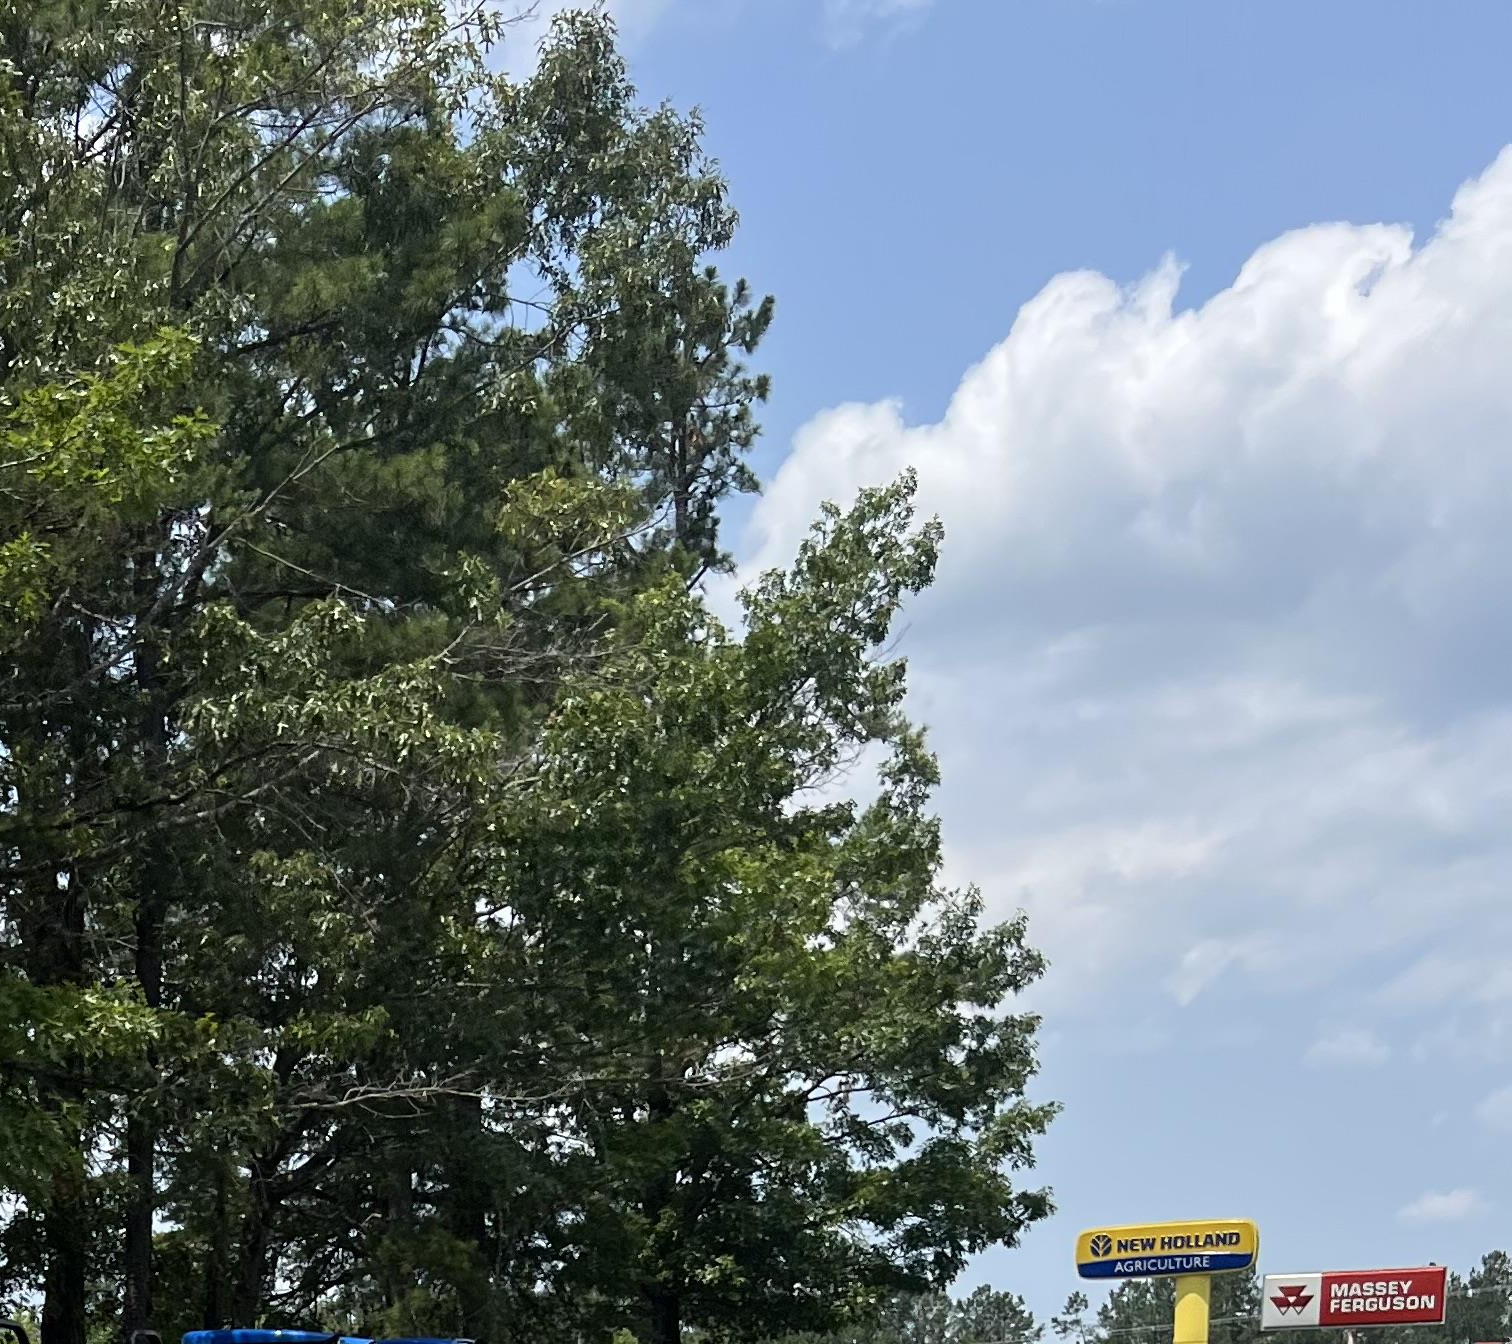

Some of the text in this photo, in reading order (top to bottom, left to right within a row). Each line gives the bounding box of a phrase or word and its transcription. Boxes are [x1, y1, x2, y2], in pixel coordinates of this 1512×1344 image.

[1117, 1232, 1240, 1253] NEW HOLLAND
[1114, 1256, 1210, 1273] AGRICULTURE
[1330, 1280, 1412, 1298] MASSEY
[1330, 1294, 1436, 1313] FERGUSON
